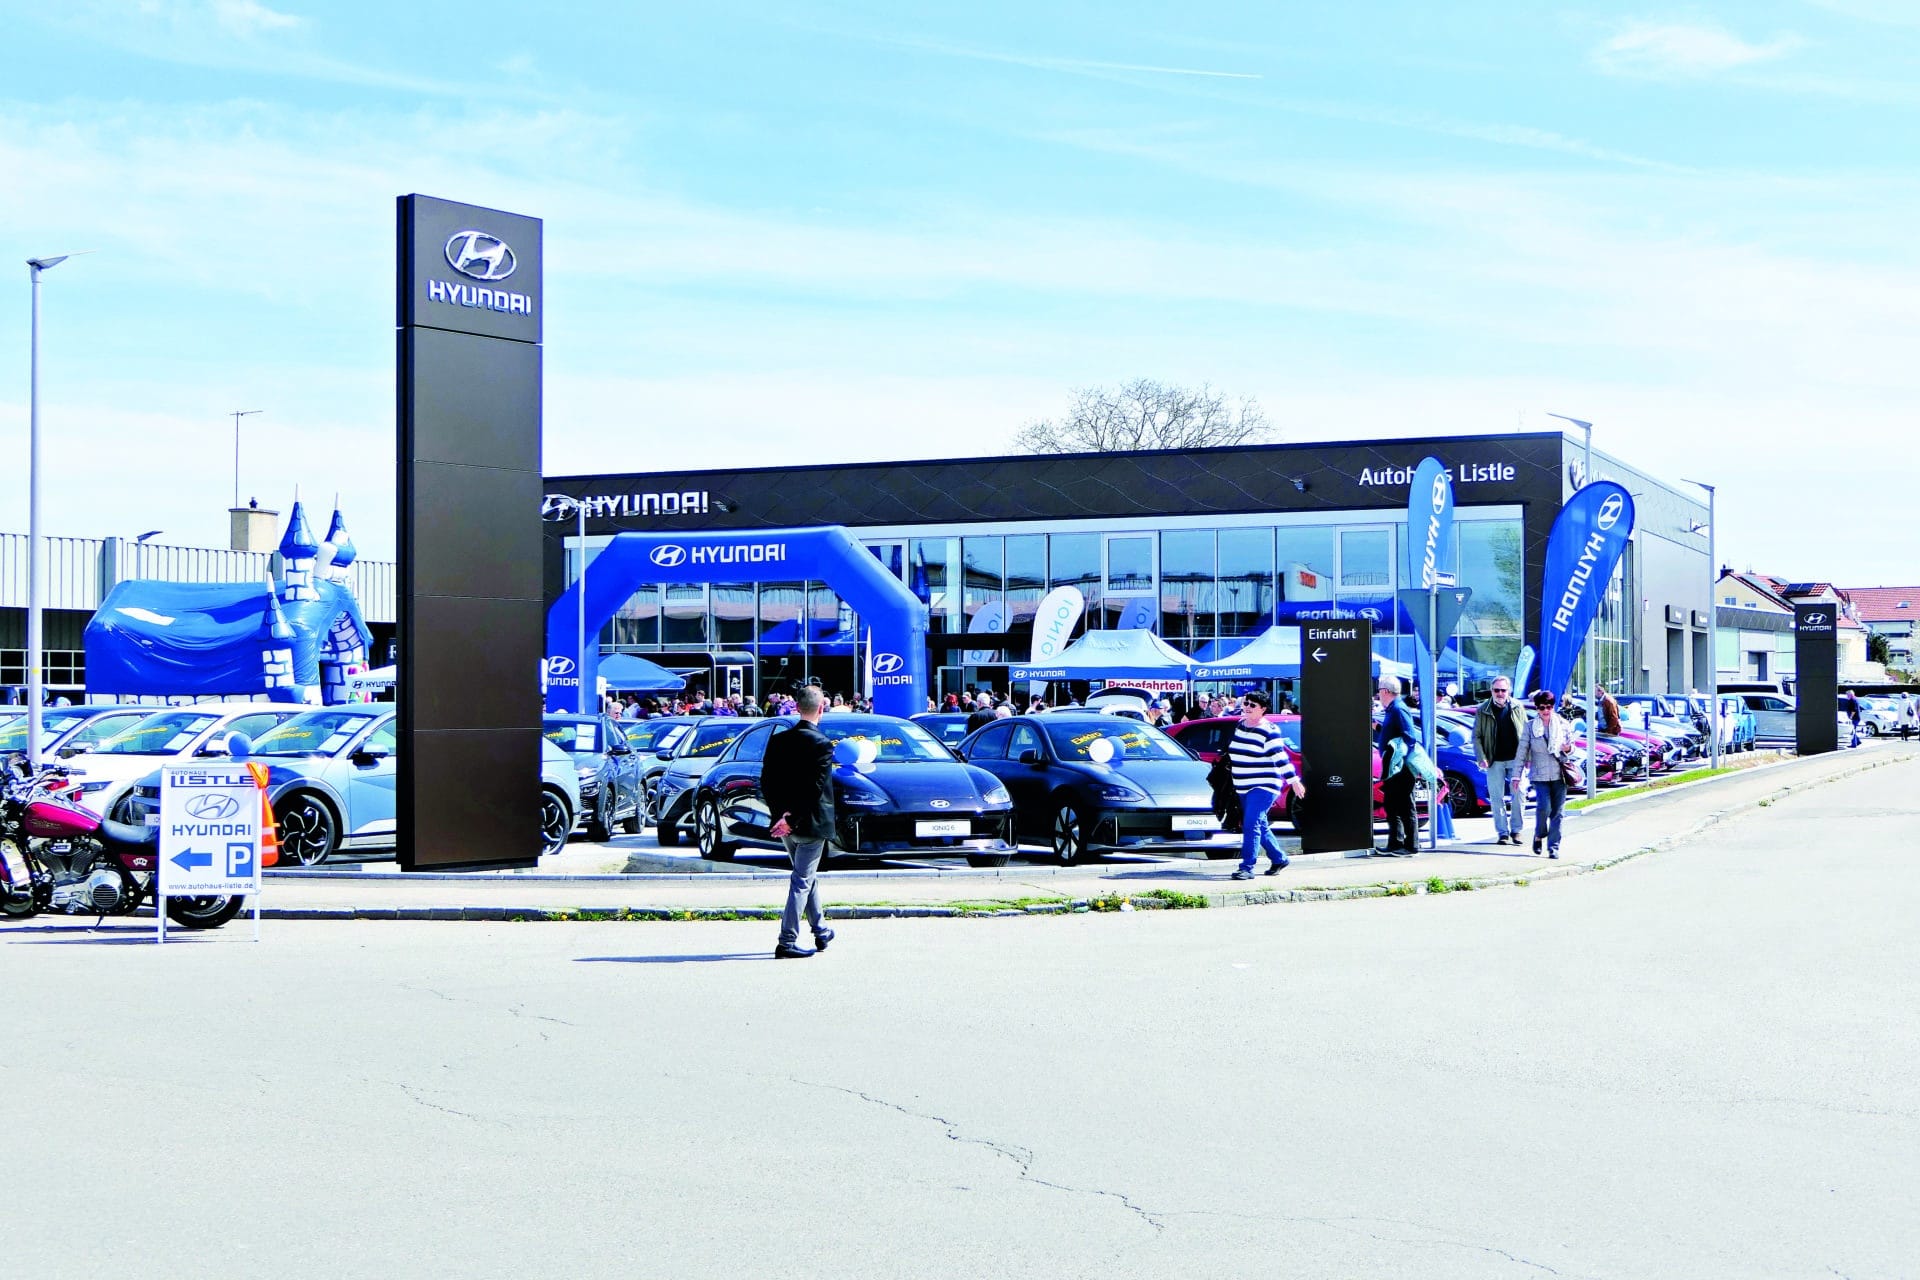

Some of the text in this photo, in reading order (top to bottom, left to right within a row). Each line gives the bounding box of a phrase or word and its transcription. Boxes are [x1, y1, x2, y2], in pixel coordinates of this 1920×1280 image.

[428, 279, 532, 317] HYUNDAI
[1358, 462, 1515, 486] Autohs Listle
[584, 491, 709, 518] HYUNDAI
[691, 543, 786, 563] HYUNDAI
[1308, 628, 1356, 640] Einfahrt
[1029, 669, 1066, 678] HYUNDAI
[1212, 667, 1252, 676] HYUNDAI
[171, 775, 254, 788] LISTLE
[172, 824, 251, 836] HYUNDAI
